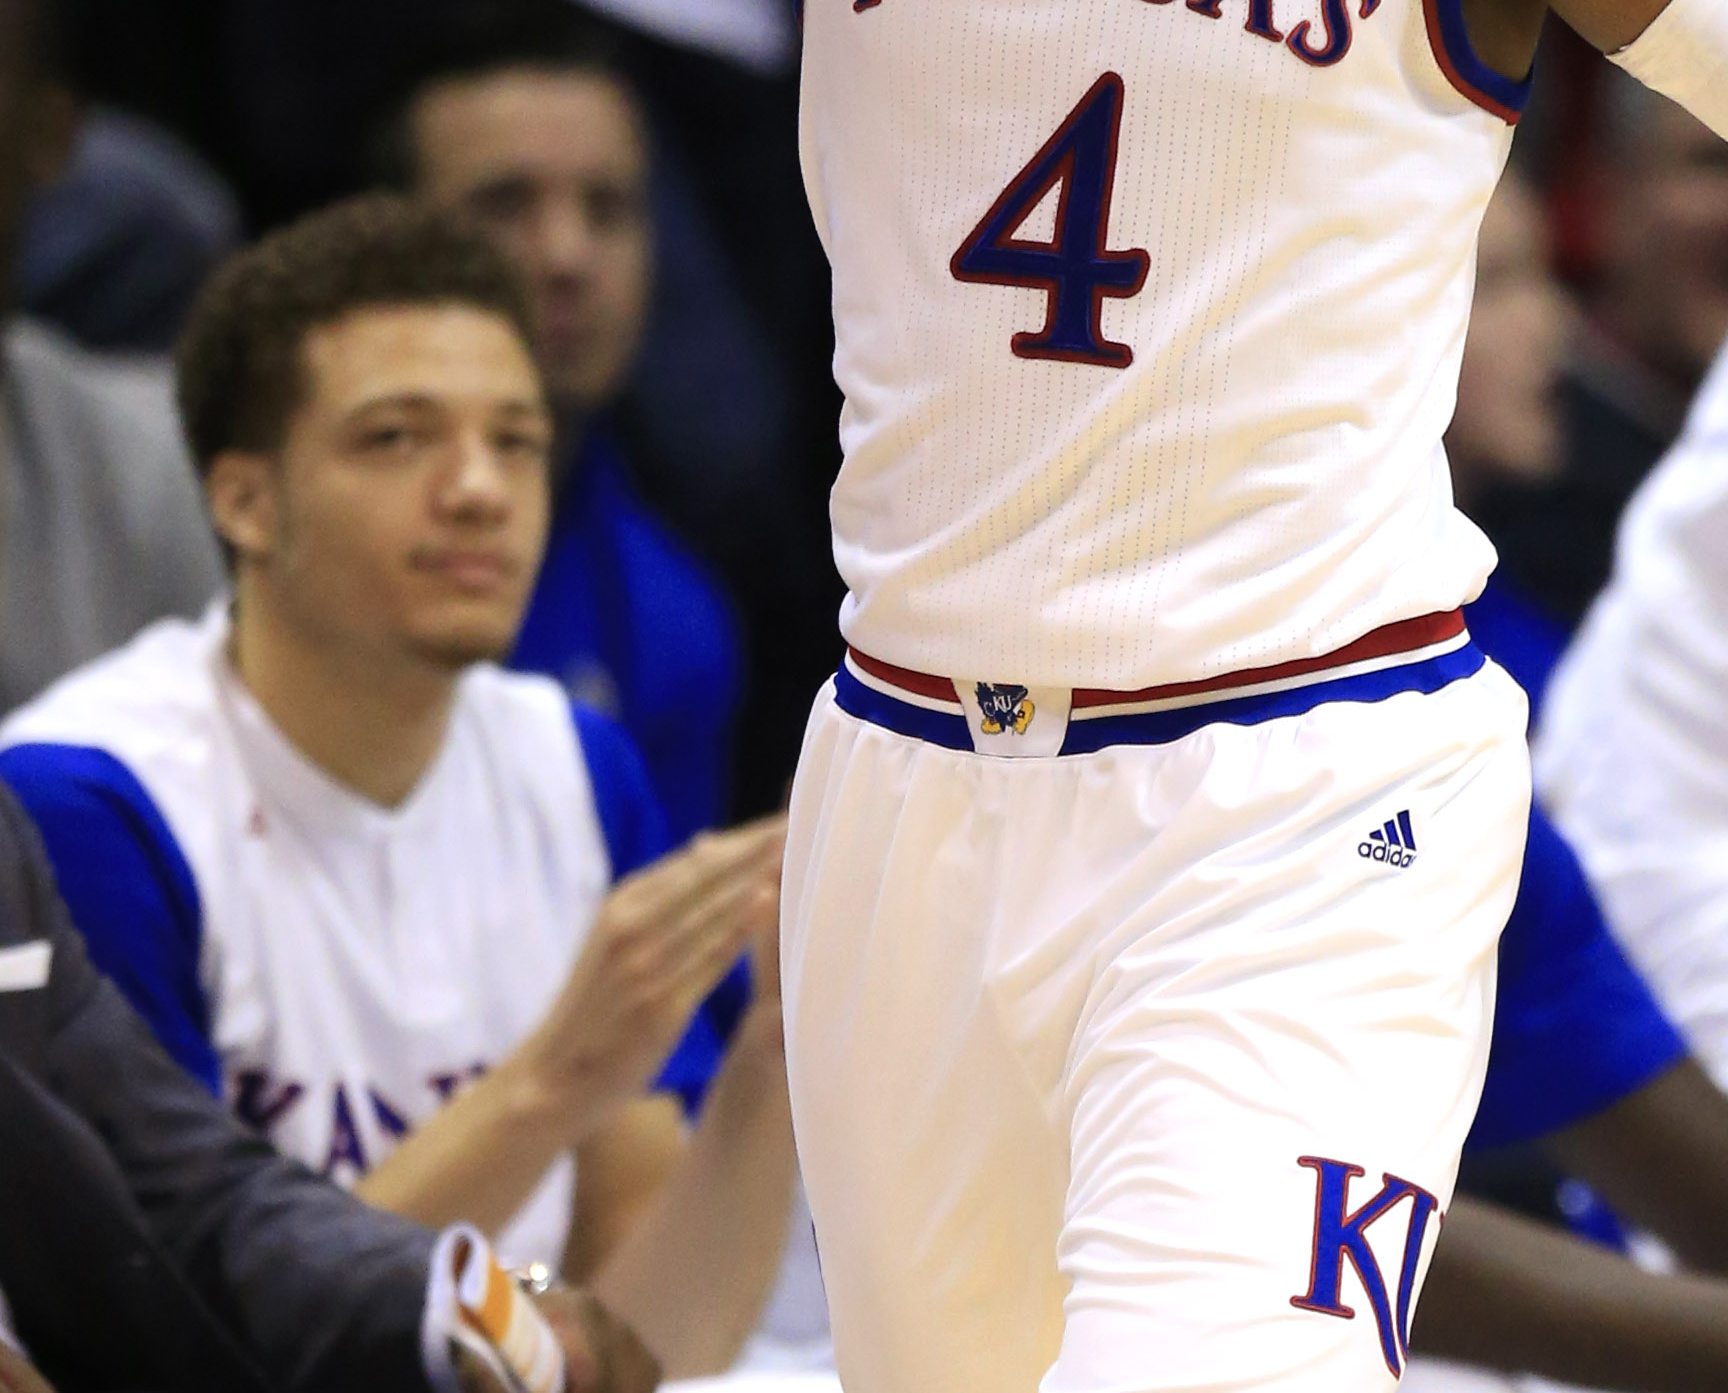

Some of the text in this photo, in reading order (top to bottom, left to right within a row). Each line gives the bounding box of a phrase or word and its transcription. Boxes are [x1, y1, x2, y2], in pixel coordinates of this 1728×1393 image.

[950, 70, 1151, 369] 4
[993, 695, 1012, 713] KU
[1357, 841, 1418, 868] adida
